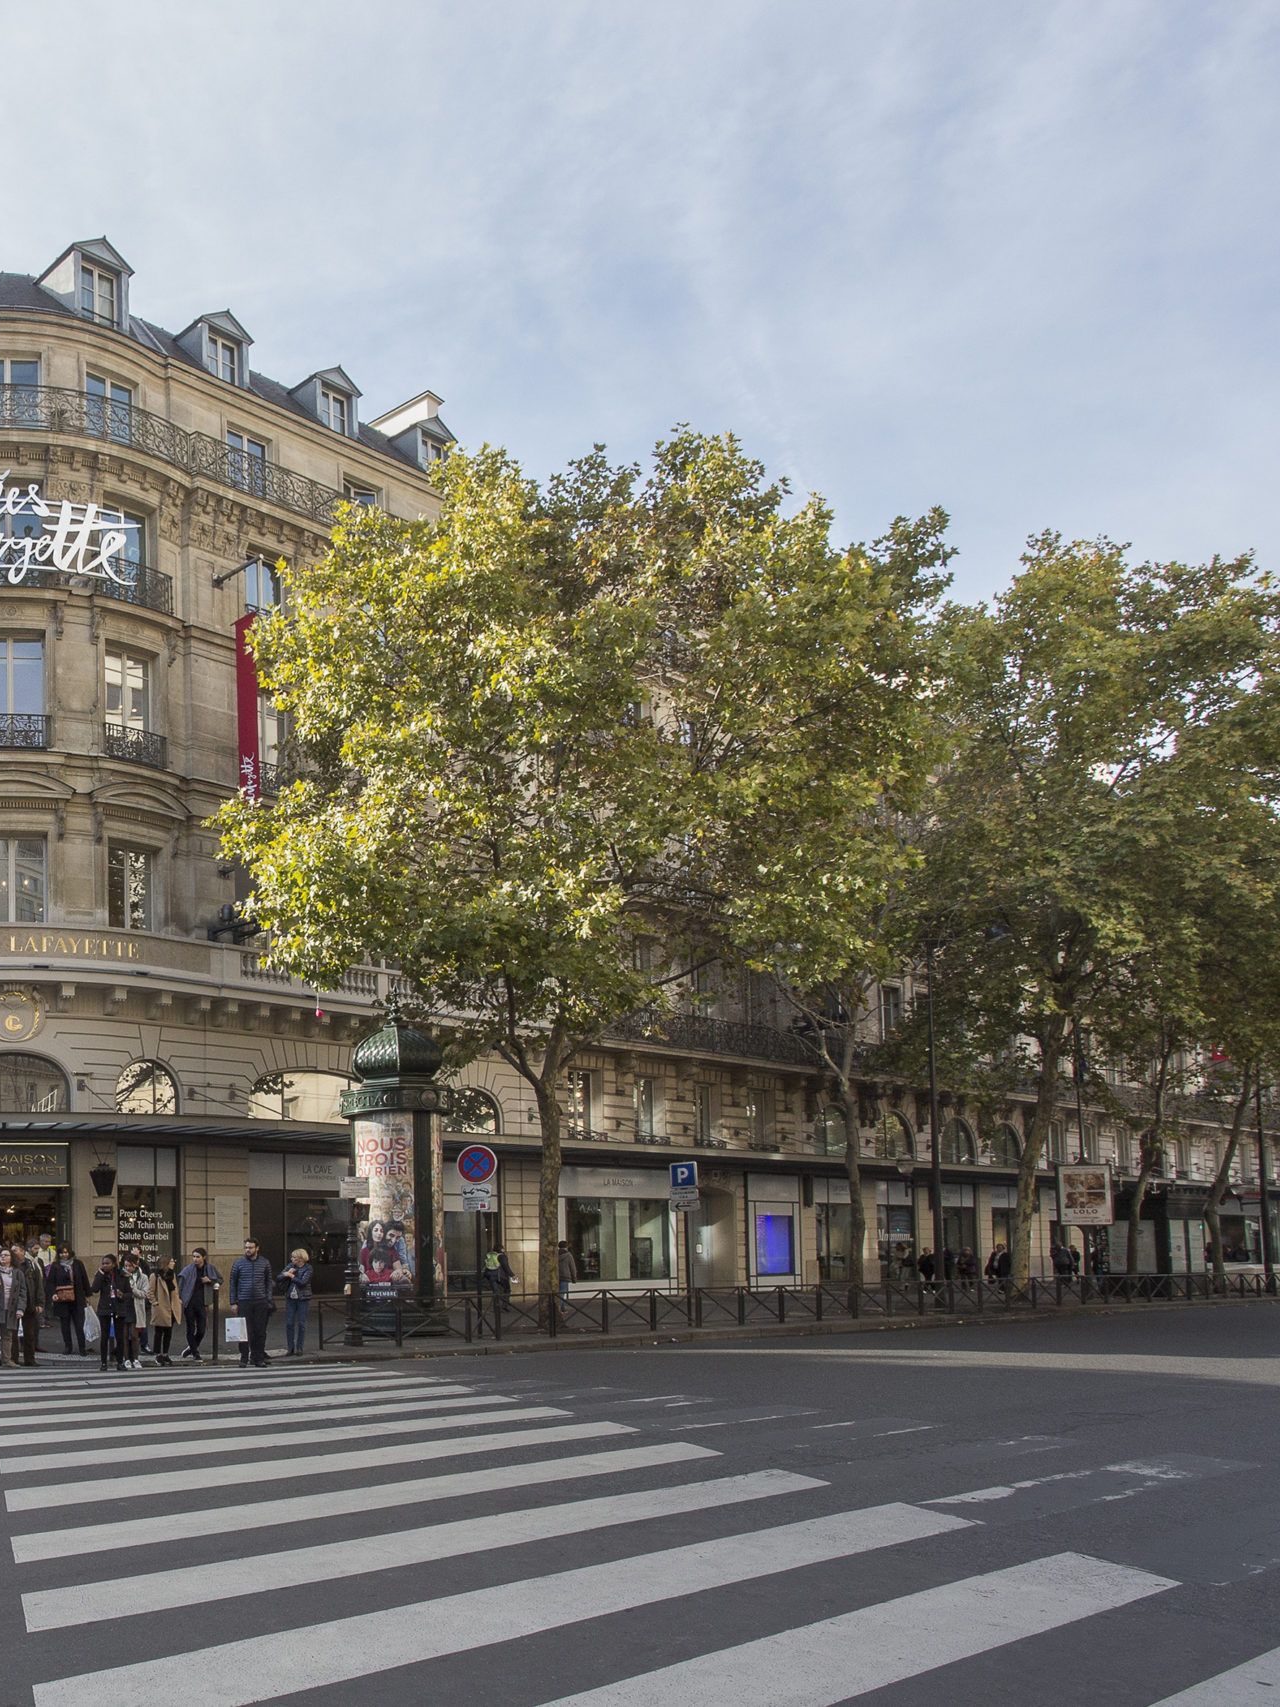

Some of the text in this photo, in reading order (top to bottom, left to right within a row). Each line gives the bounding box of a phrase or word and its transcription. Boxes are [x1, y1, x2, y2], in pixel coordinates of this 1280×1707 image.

[10, 935, 140, 959] LAFAYETTE
[357, 1137, 406, 1153] NOUS
[358, 1152, 408, 1167] TROIS
[302, 1164, 333, 1175] LA CAVE
[358, 1165, 407, 1177] OU RIEN
[677, 1167, 689, 1184] P
[119, 1209, 137, 1218] Prost
[140, 1210, 163, 1218] Cheers
[137, 1221, 155, 1229] Tchin
[157, 1221, 174, 1229] tchin
[119, 1232, 141, 1240] Salute
[118, 1243, 129, 1251] Na
